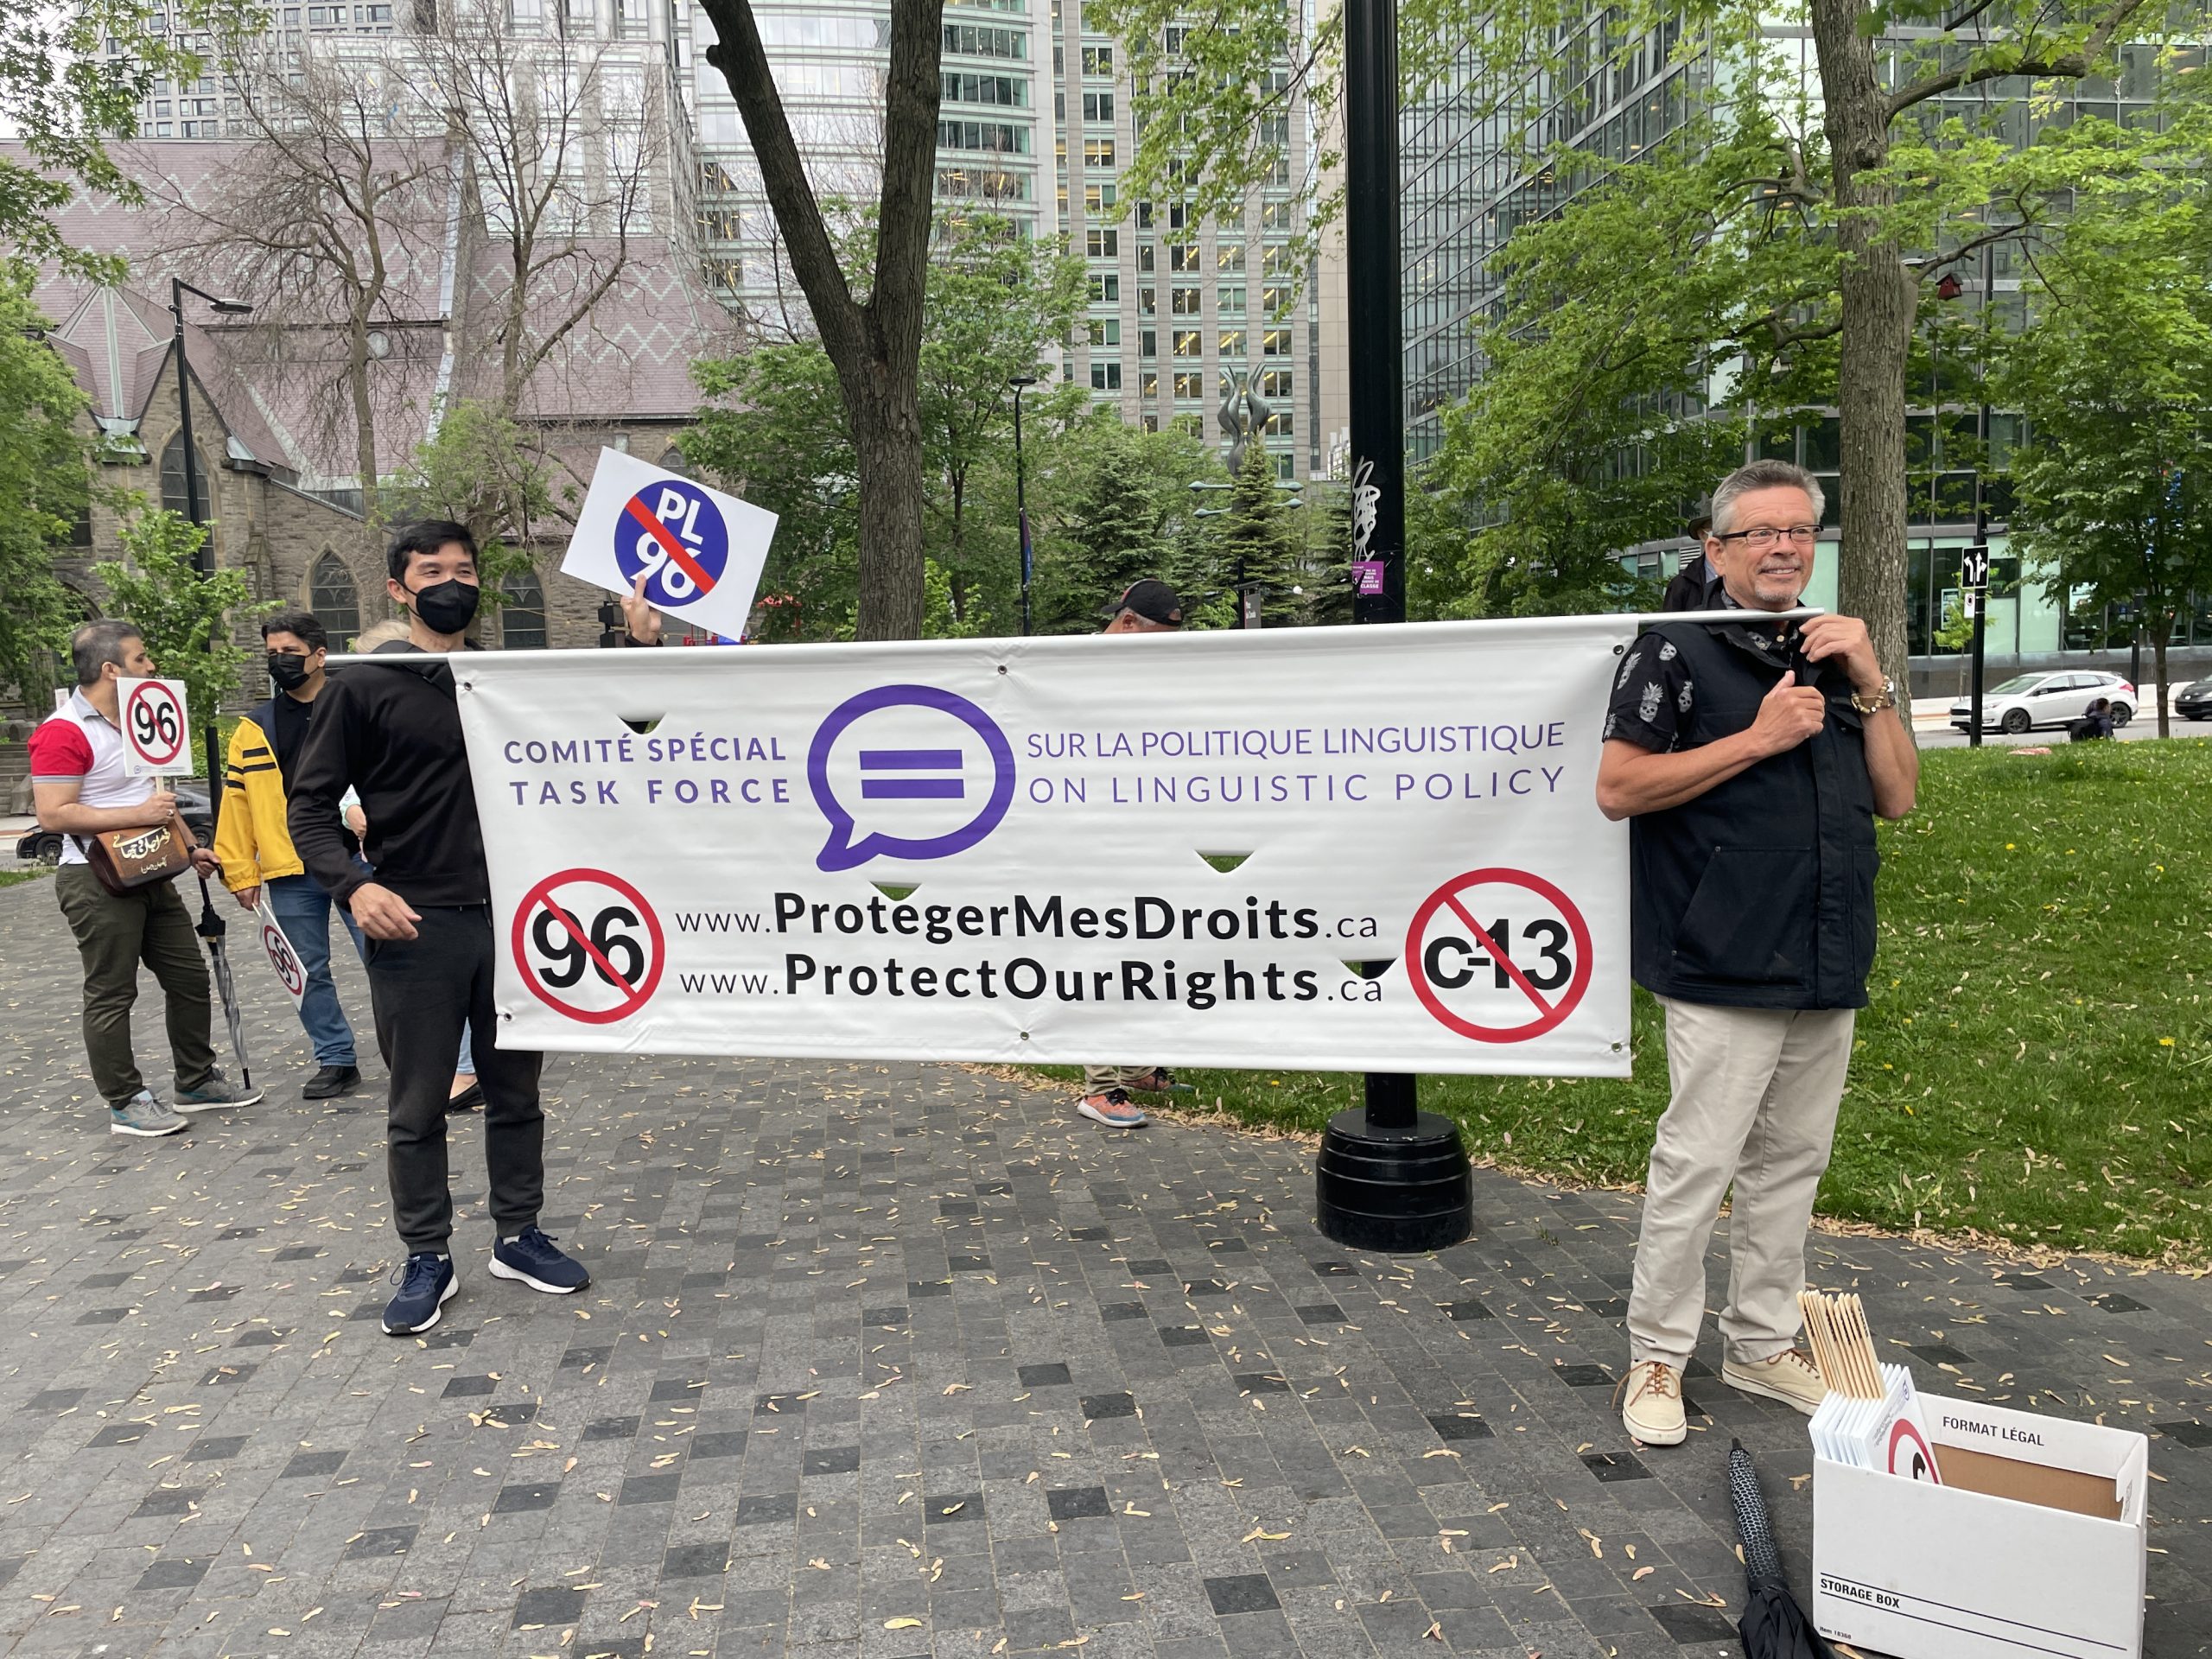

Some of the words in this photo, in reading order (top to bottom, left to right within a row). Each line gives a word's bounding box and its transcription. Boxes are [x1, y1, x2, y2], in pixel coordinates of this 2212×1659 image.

[656, 487, 703, 545] PL
[630, 531, 702, 599] 96
[135, 701, 177, 745] 96
[1027, 733, 1086, 758] SUR
[1096, 732, 1134, 758] LA
[1141, 728, 1313, 760] POLITIQUE
[1324, 721, 1565, 755] LINGUISTIQUE
[504, 732, 634, 764] COMITÉ
[647, 731, 786, 762] SPÉCIAL
[509, 780, 619, 805] TASK
[647, 779, 790, 804] FORCE
[1029, 777, 1086, 804] ON
[1112, 773, 1368, 803] LINGUISTIC
[1395, 766, 1564, 800] POLICY
[675, 892, 1378, 944] www.ProtegerMesDroits.ca
[532, 906, 645, 988] 96
[679, 953, 1382, 1010] www.ProtectOurRights.ca
[1942, 1415, 1999, 1438] FORMAT
[2002, 1424, 2045, 1446] LÉGAL
[1821, 1578, 1872, 1601] STORAGE
[1876, 1593, 1900, 1608] BOX
